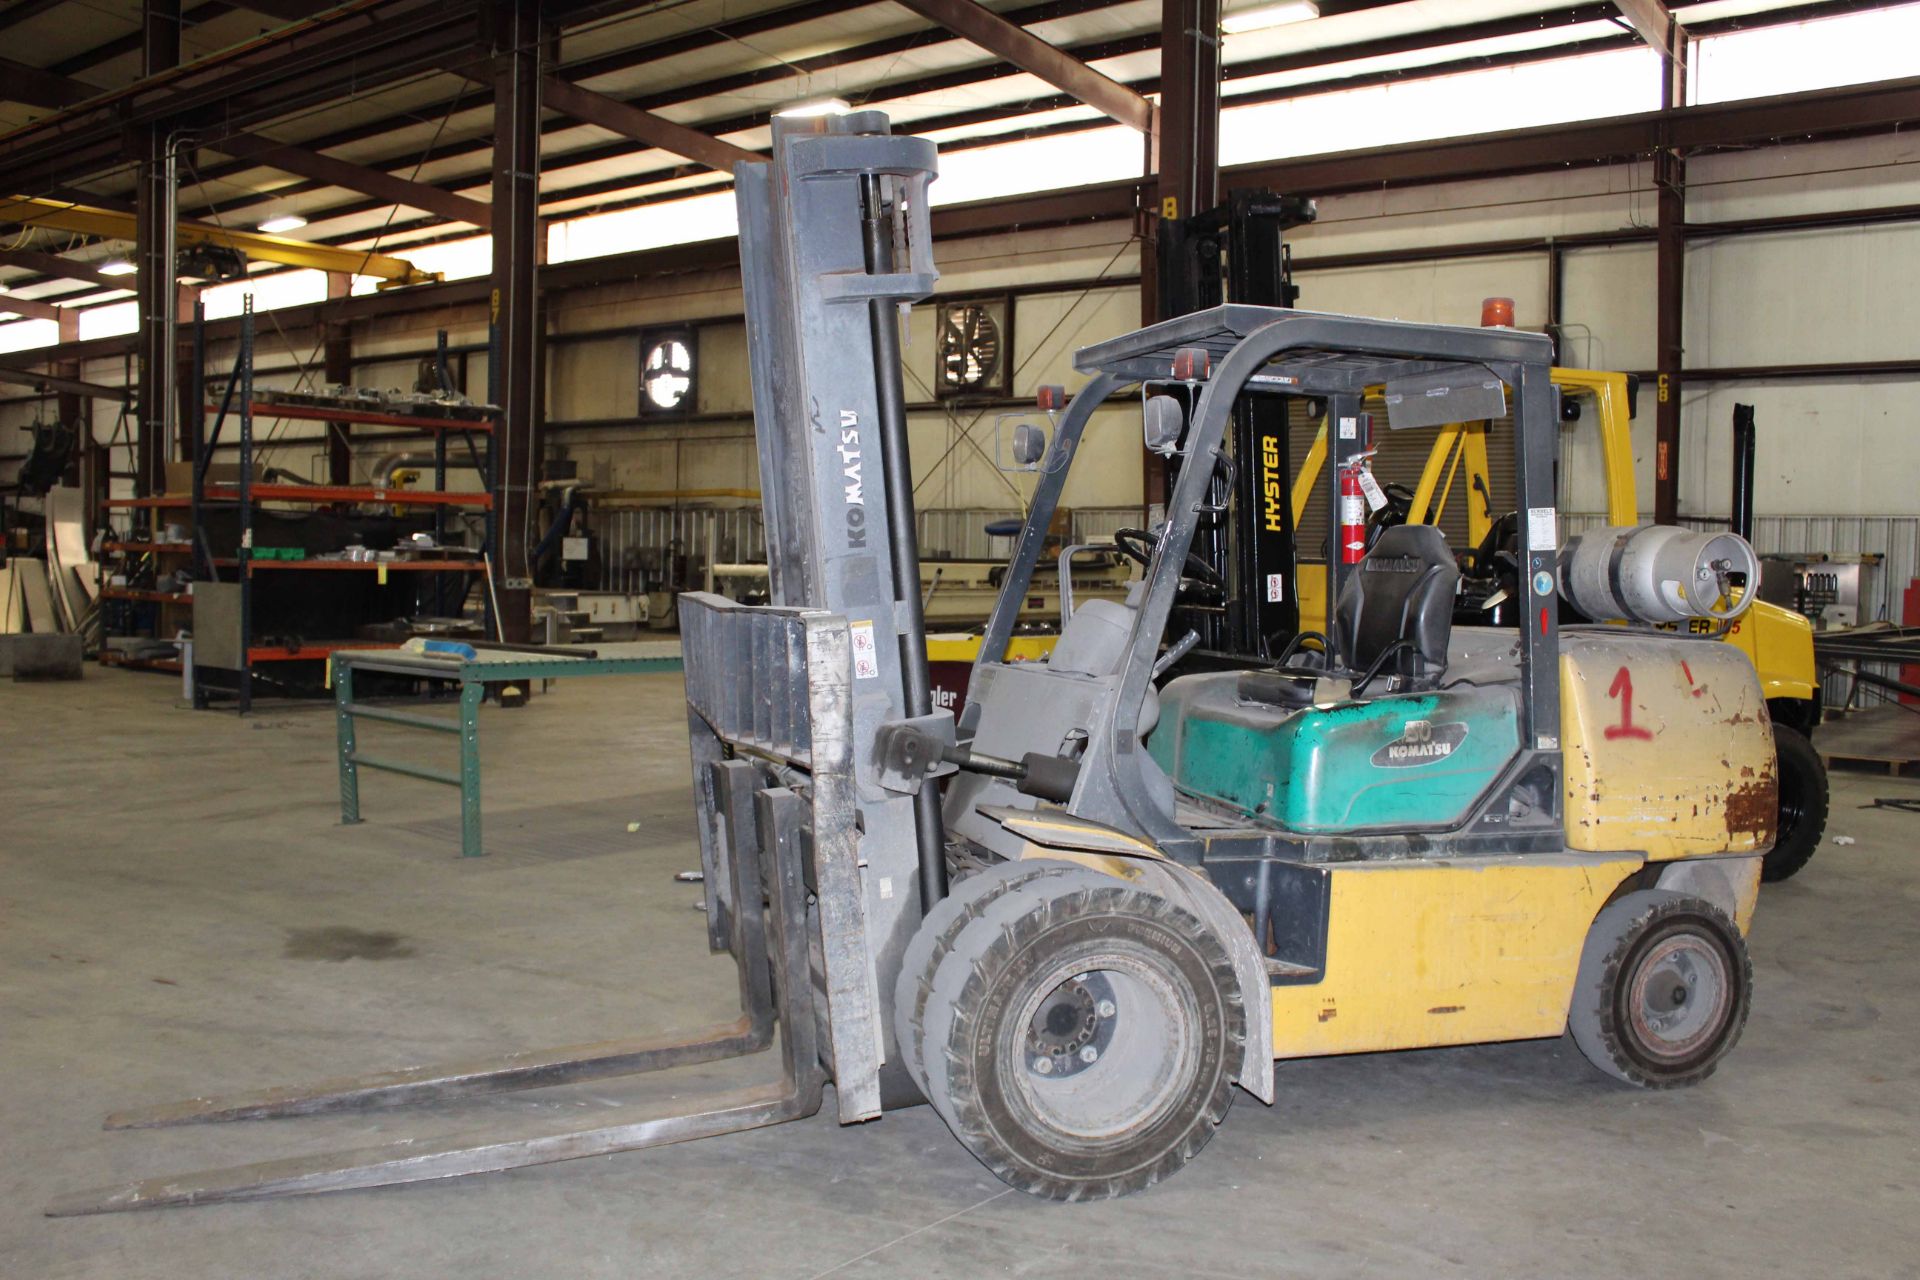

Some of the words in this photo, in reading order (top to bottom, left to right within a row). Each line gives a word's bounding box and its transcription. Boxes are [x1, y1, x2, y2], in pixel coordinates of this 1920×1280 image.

[837, 410, 867, 549] KOMATSU
[1262, 434, 1281, 532] HYSTER
[1604, 666, 1652, 741] 1
[1389, 741, 1451, 758] KOMATSU
